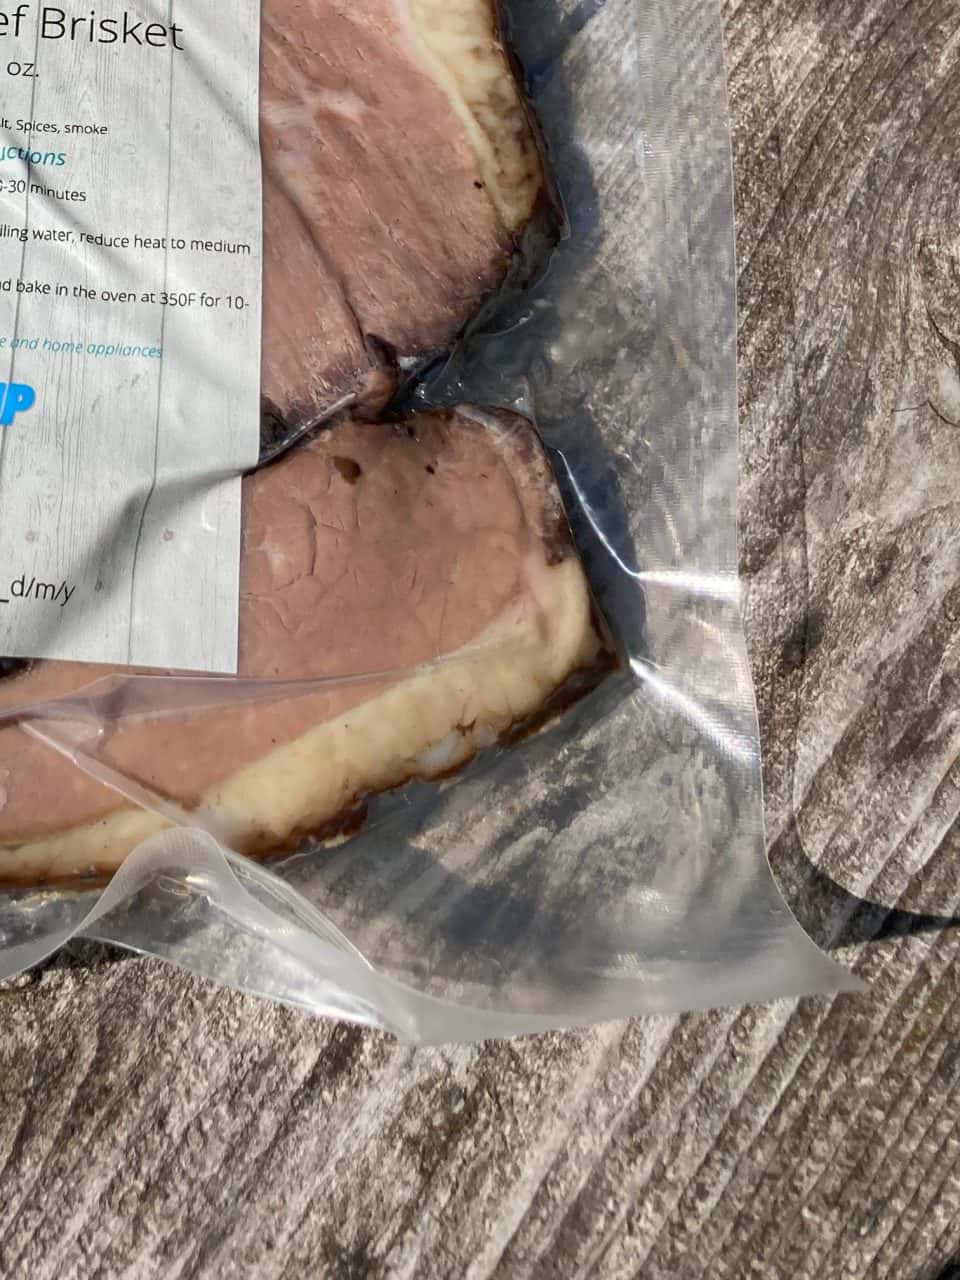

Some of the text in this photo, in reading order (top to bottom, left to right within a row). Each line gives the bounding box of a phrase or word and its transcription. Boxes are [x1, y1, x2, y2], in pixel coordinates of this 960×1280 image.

[41, 7, 185, 51] Brisket
[7, 61, 40, 78] oz.
[16, 119, 60, 134] Spices,
[64, 123, 108, 135] smoke
[30, 183, 87, 202] minutes
[32, 227, 75, 243] water,
[80, 233, 129, 249] reduce
[134, 234, 166, 249] heat
[170, 238, 186, 250] to
[190, 239, 251, 255] medium
[16, 279, 51, 295] bake
[55, 282, 68, 296] in
[73, 284, 96, 300] the
[101, 290, 136, 303] oven
[140, 292, 155, 304] at
[159, 292, 196, 307] 350F
[199, 292, 221, 308] for
[225, 296, 250, 310] 10-
[10, 335, 38, 349] and
[42, 338, 83, 353] home
[87, 341, 162, 358] appliances
[10, 575, 76, 606] d/m/y
